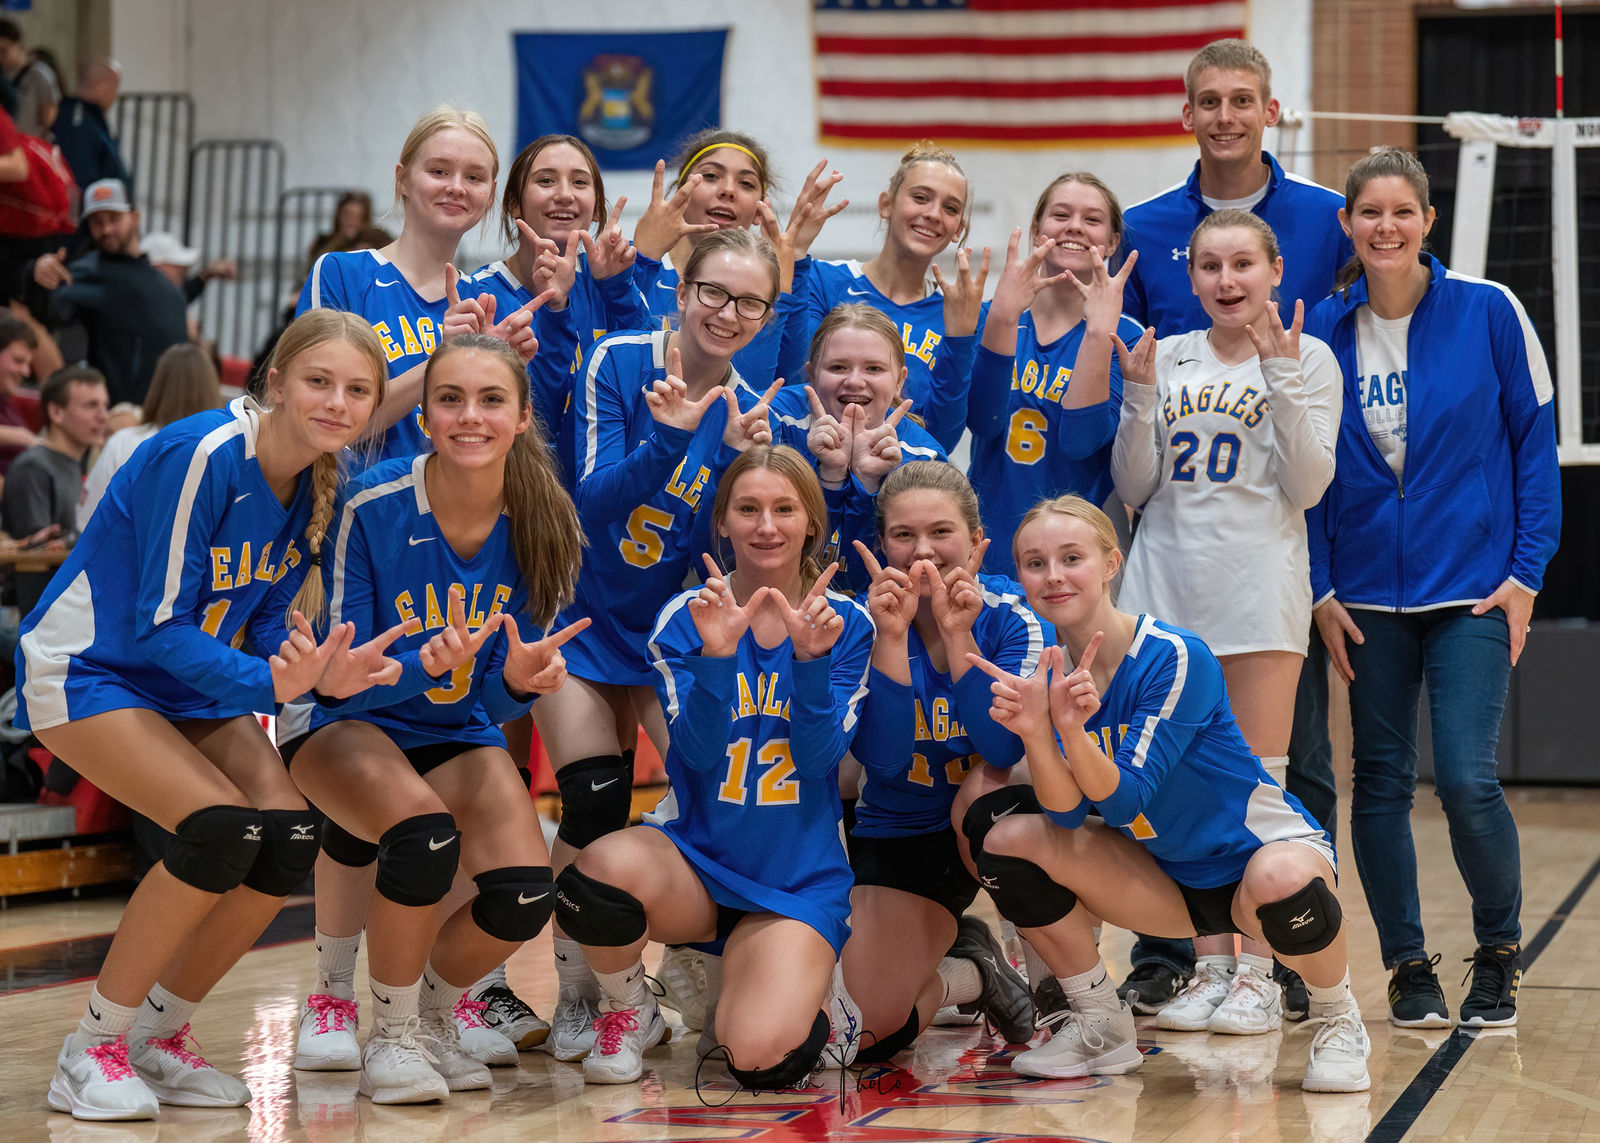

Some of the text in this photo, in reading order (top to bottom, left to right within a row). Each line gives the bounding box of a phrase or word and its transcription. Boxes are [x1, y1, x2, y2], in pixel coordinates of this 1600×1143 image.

[372, 315, 444, 363] EAG
[1163, 381, 1270, 430] EAGLES
[1005, 407, 1048, 465] 6
[1170, 431, 1242, 483] 20
[618, 503, 676, 570] 5
[717, 736, 801, 806] 12
